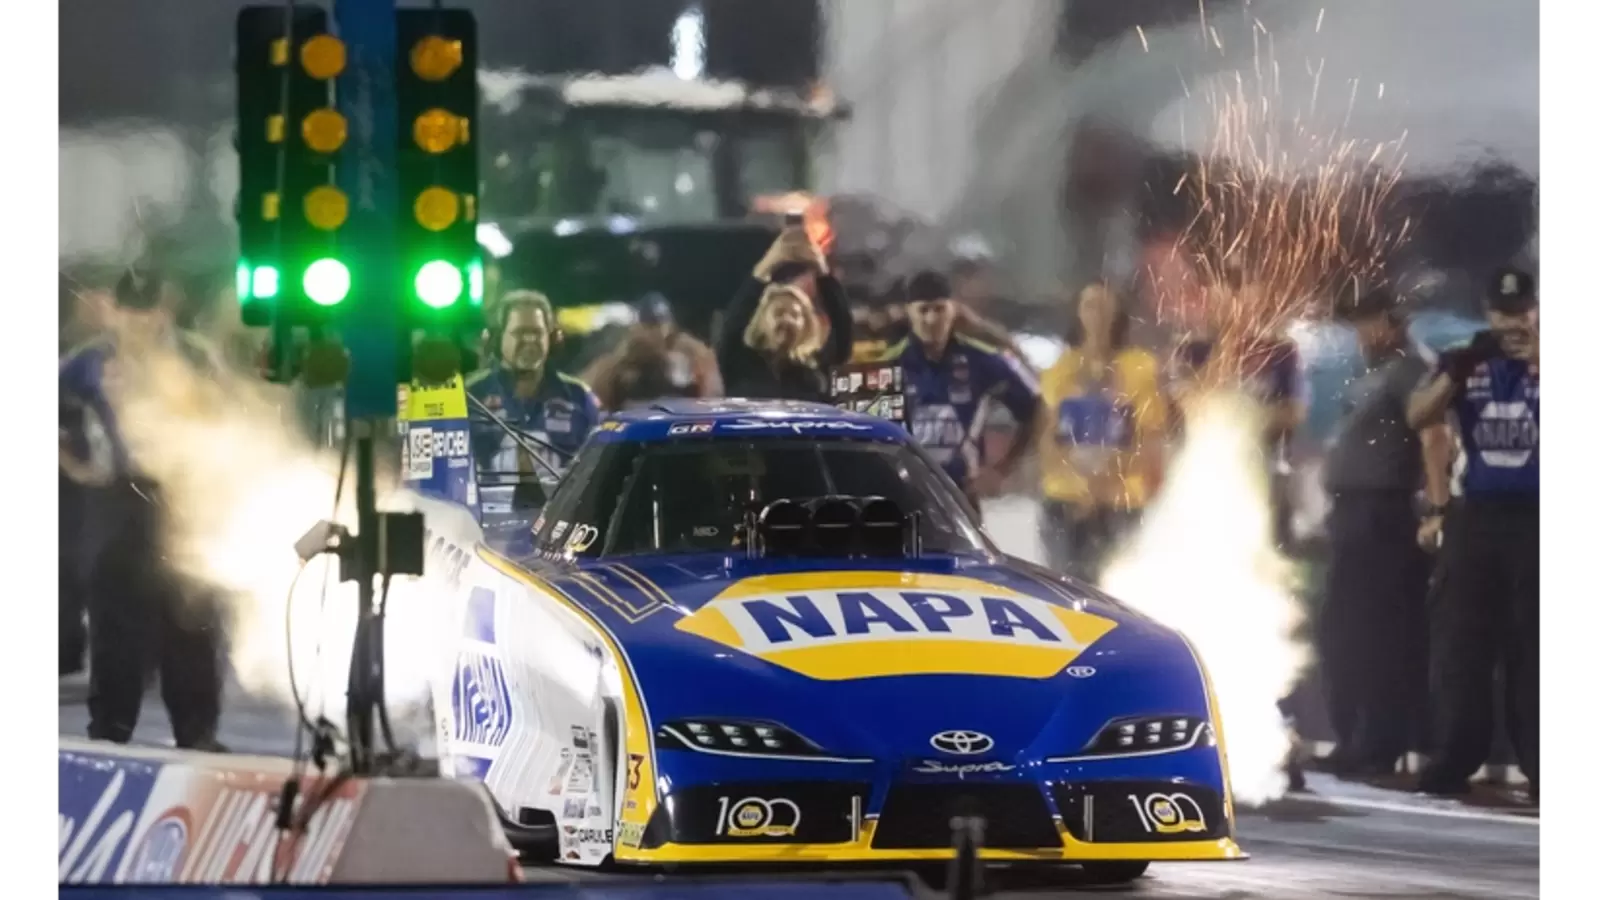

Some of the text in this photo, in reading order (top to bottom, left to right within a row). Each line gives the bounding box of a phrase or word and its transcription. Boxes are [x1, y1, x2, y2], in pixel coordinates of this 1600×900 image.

[670, 418, 873, 435] GR Supra
[740, 591, 1062, 644] NAPA
[911, 759, 1017, 780] Supra
